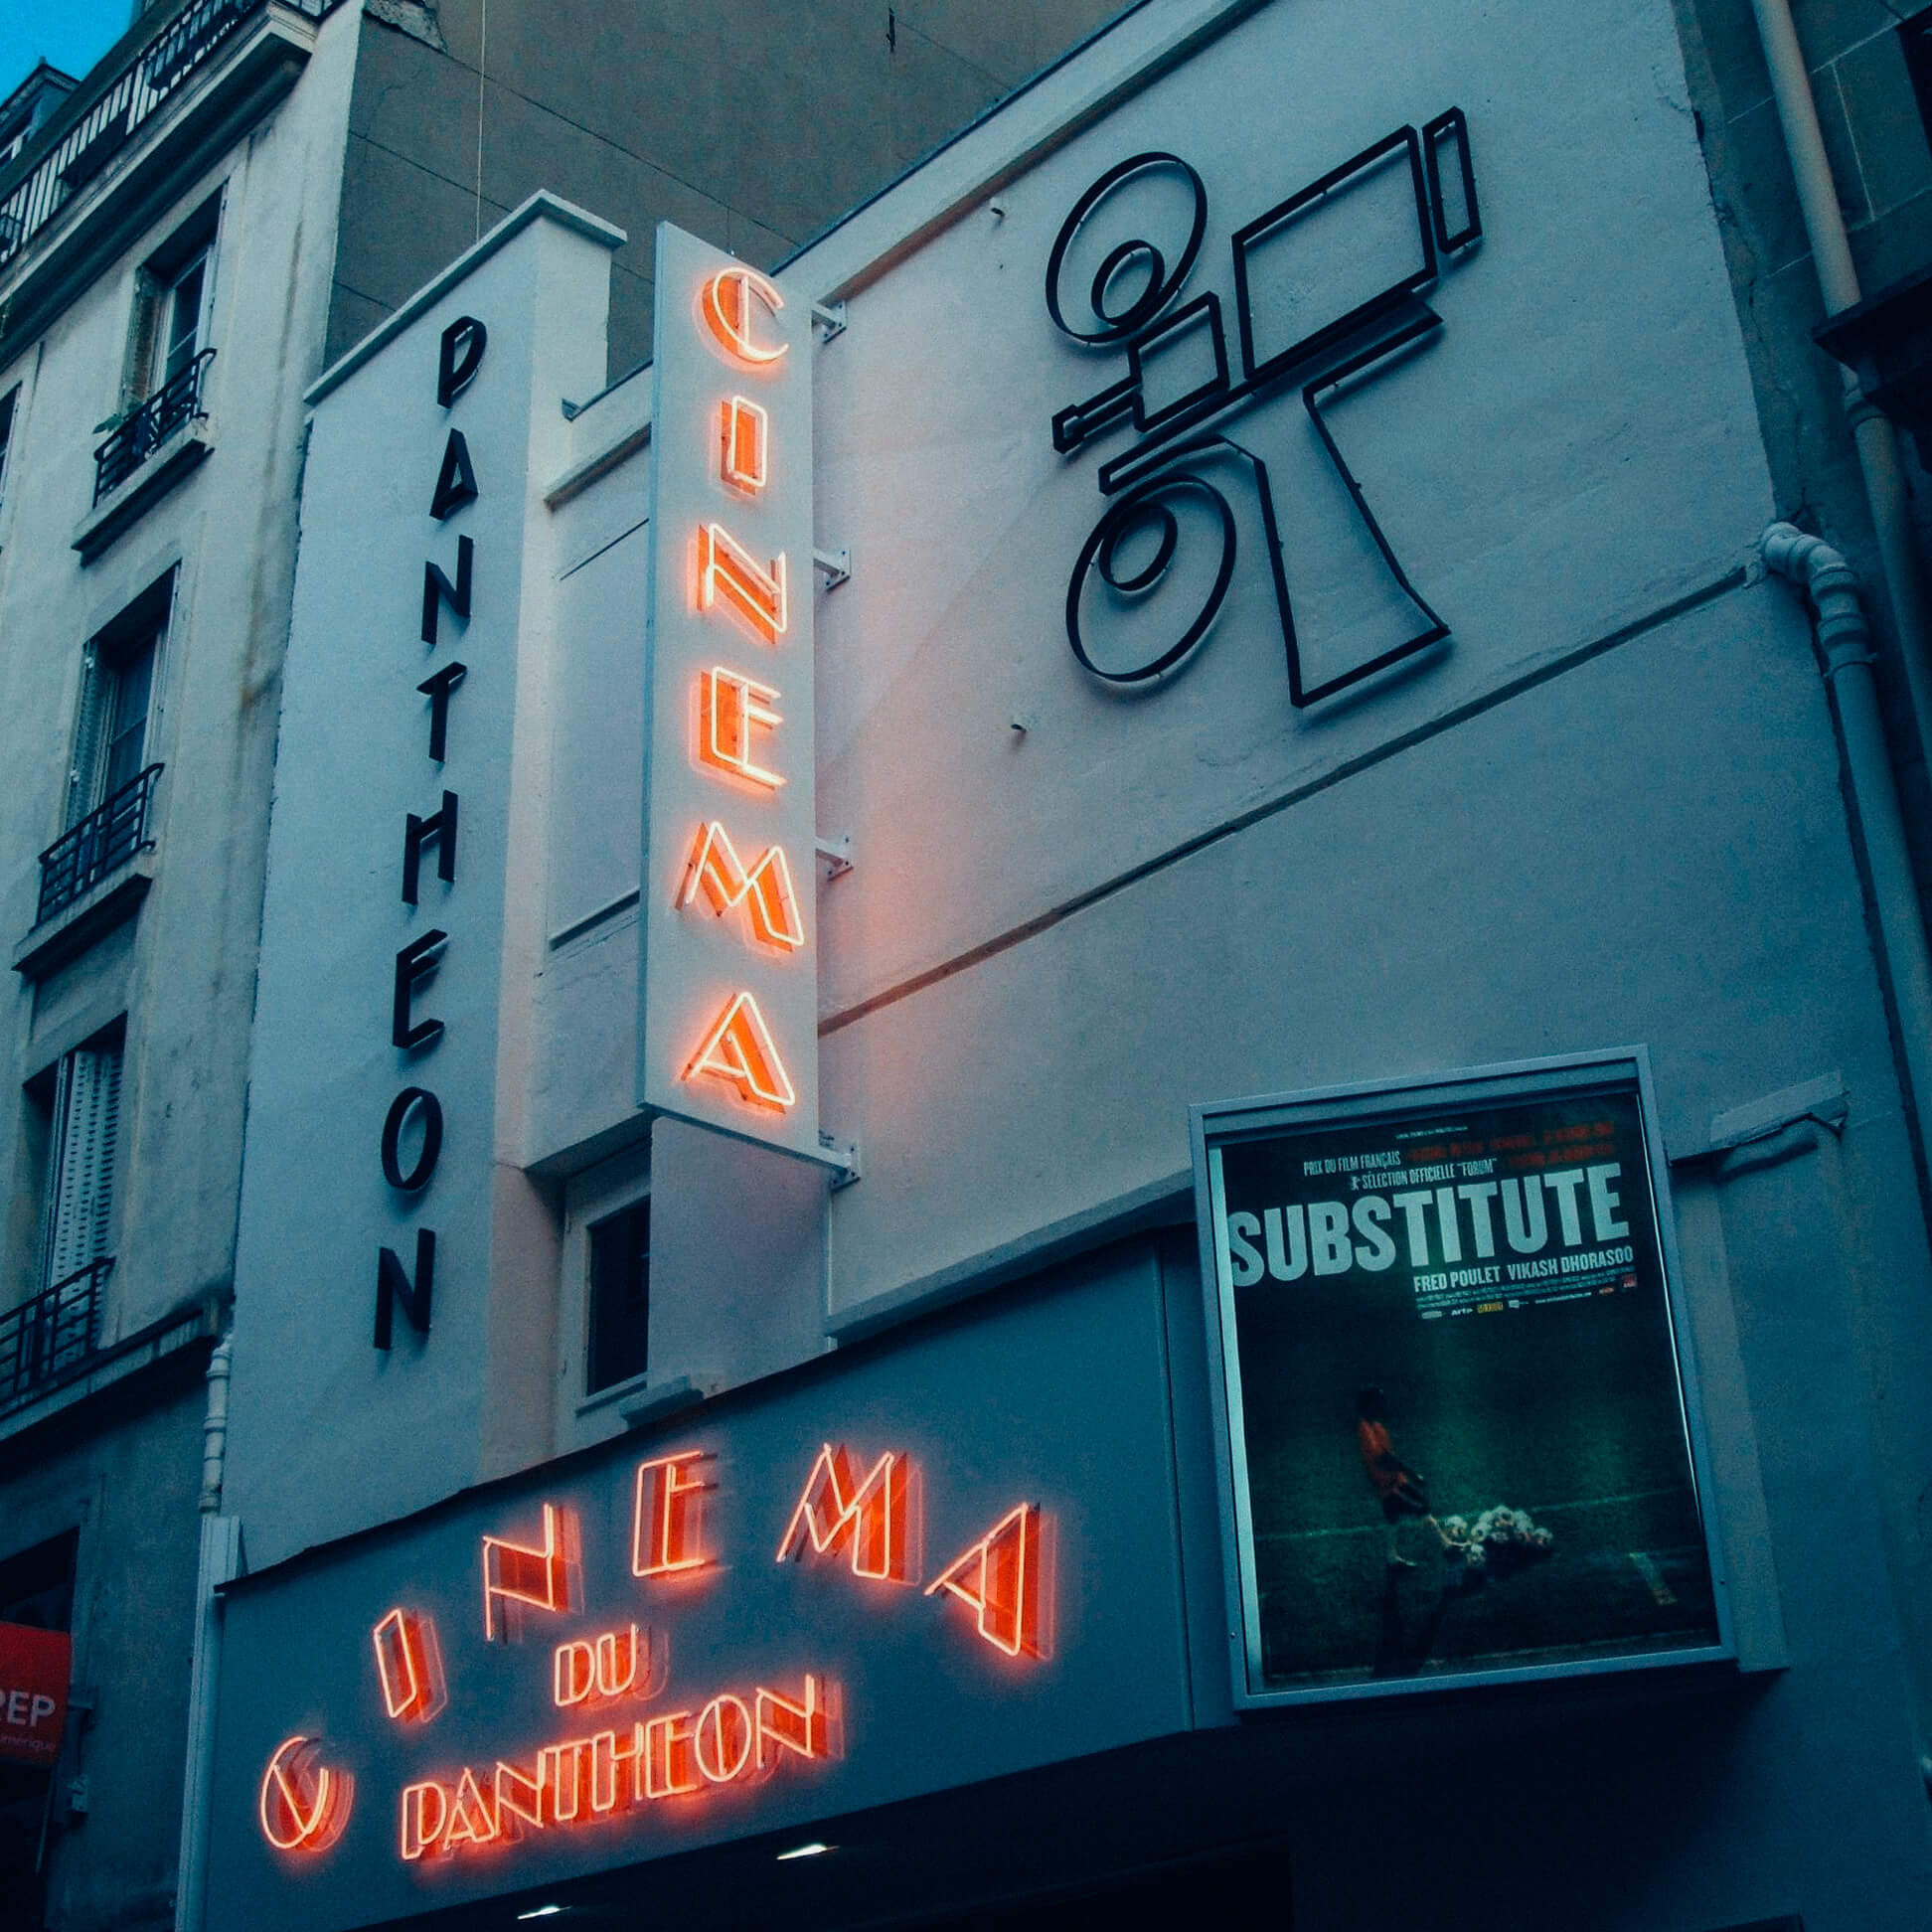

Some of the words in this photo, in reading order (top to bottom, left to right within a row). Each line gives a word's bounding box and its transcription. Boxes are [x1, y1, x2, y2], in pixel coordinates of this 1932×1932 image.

[679, 266, 804, 1113] CINEMA
[375, 316, 486, 1350] PANTHEON
[1227, 1163, 1629, 1287] SUBSTITUTE
[1304, 1160, 1323, 1177] PRIX
[1325, 1158, 1336, 1174] DU
[1338, 1155, 1359, 1172] FILM
[1361, 1150, 1401, 1170] FRANÇAIS
[1362, 1170, 1408, 1190] SÉLECTION
[1409, 1164, 1456, 1185] OFFICIELLE
[1413, 1273, 1448, 1292] FRED
[1450, 1265, 1501, 1289] POULET
[1508, 1257, 1558, 1281] VIKASH
[1560, 1245, 1634, 1273] DHORASOO
[259, 1443, 1040, 1852] CINEMA
[554, 1623, 642, 1708] DU
[401, 1674, 829, 1861] PANTHEON
